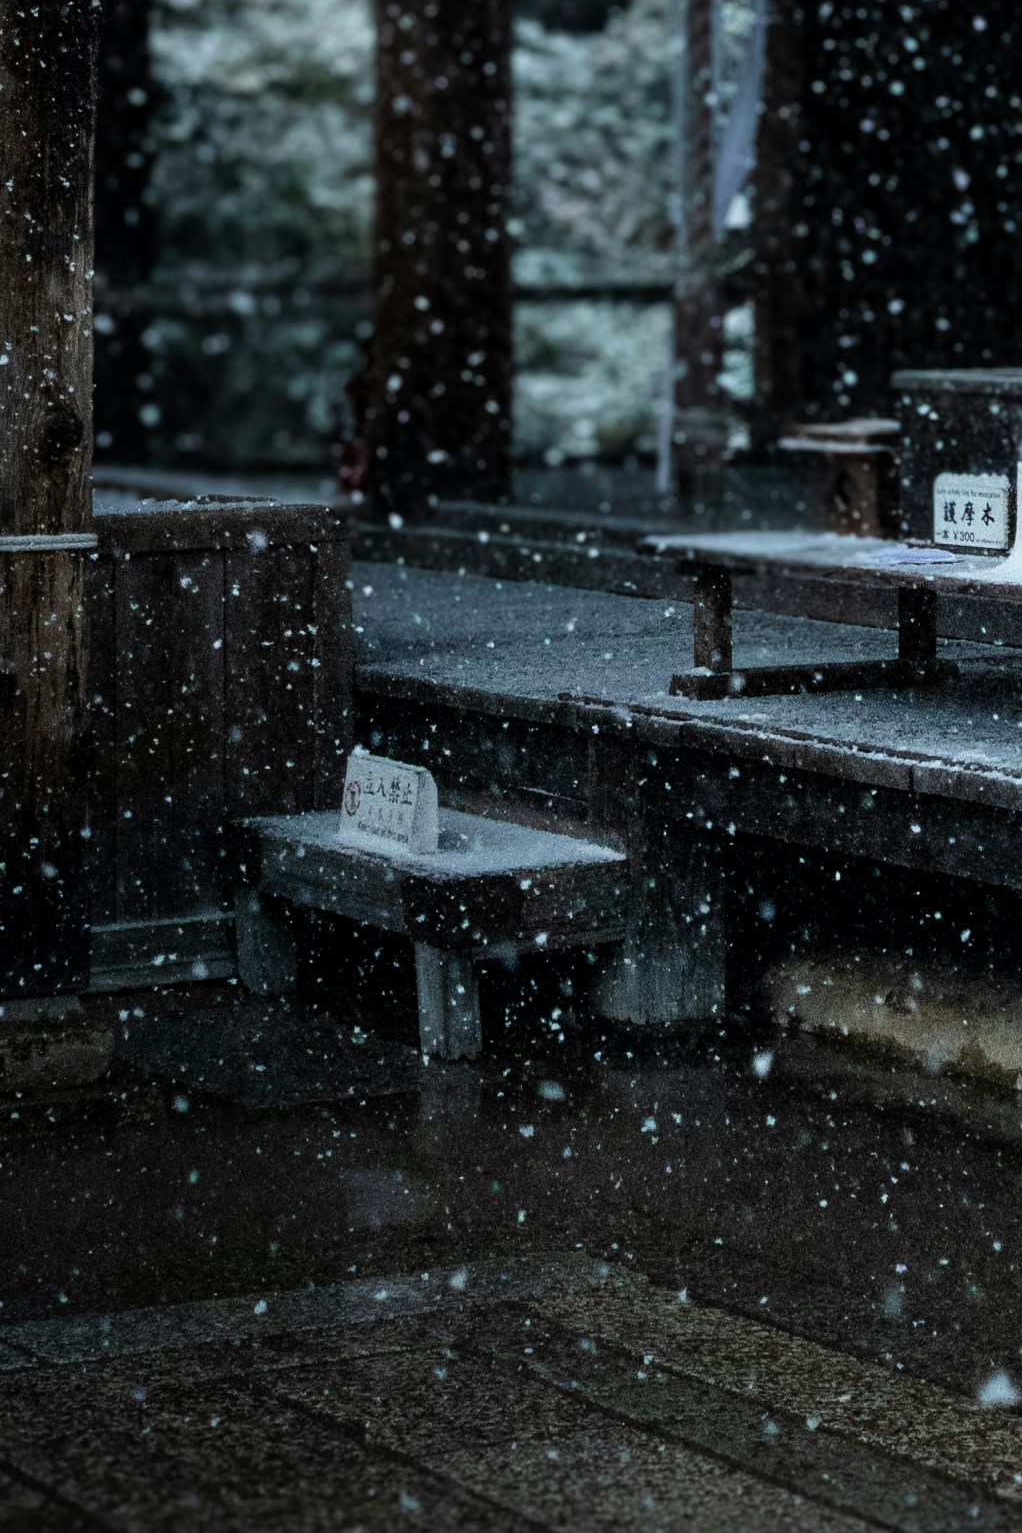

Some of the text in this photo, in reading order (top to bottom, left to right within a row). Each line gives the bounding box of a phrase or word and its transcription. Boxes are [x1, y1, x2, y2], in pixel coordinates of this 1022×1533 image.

[943, 501, 996, 526] 護摩木
[953, 532, 976, 543] ¥300
